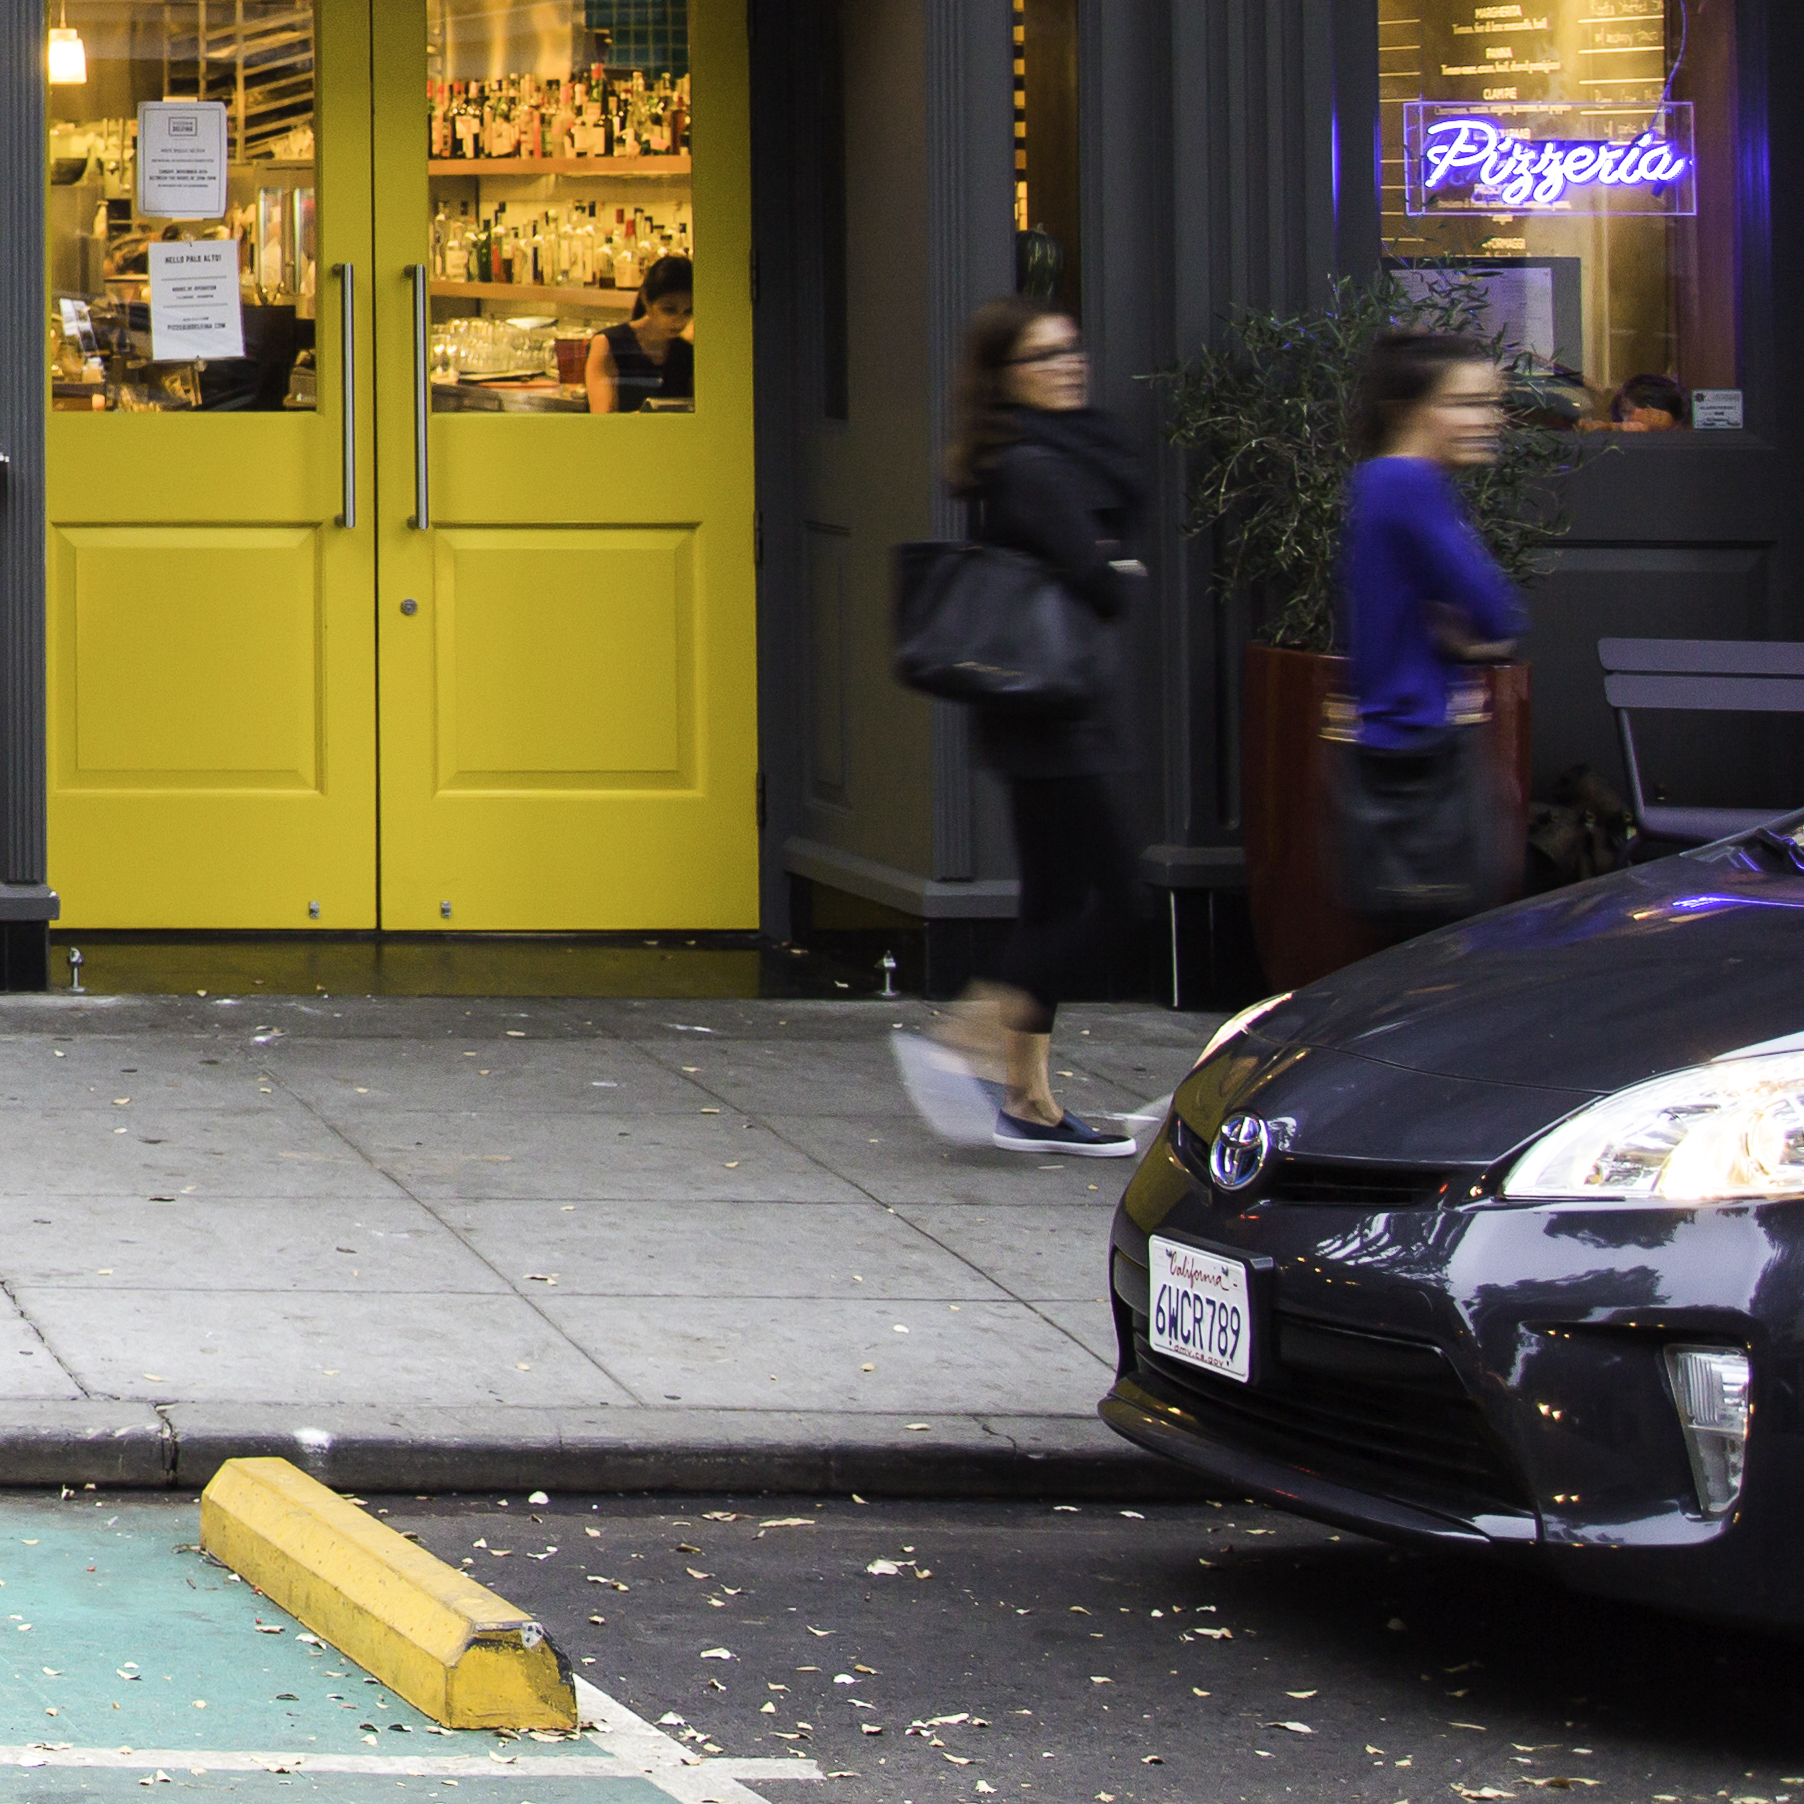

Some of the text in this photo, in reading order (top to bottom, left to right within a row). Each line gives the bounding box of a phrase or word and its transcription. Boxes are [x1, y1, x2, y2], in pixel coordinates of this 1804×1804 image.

[1424, 118, 1686, 205] Pizzeria
[165, 256, 184, 264] HELLO
[1169, 1251, 1229, 1292] California
[1156, 1283, 1241, 1361] 6WCR789
[1173, 1345, 1224, 1367] dmv.ca.gov
